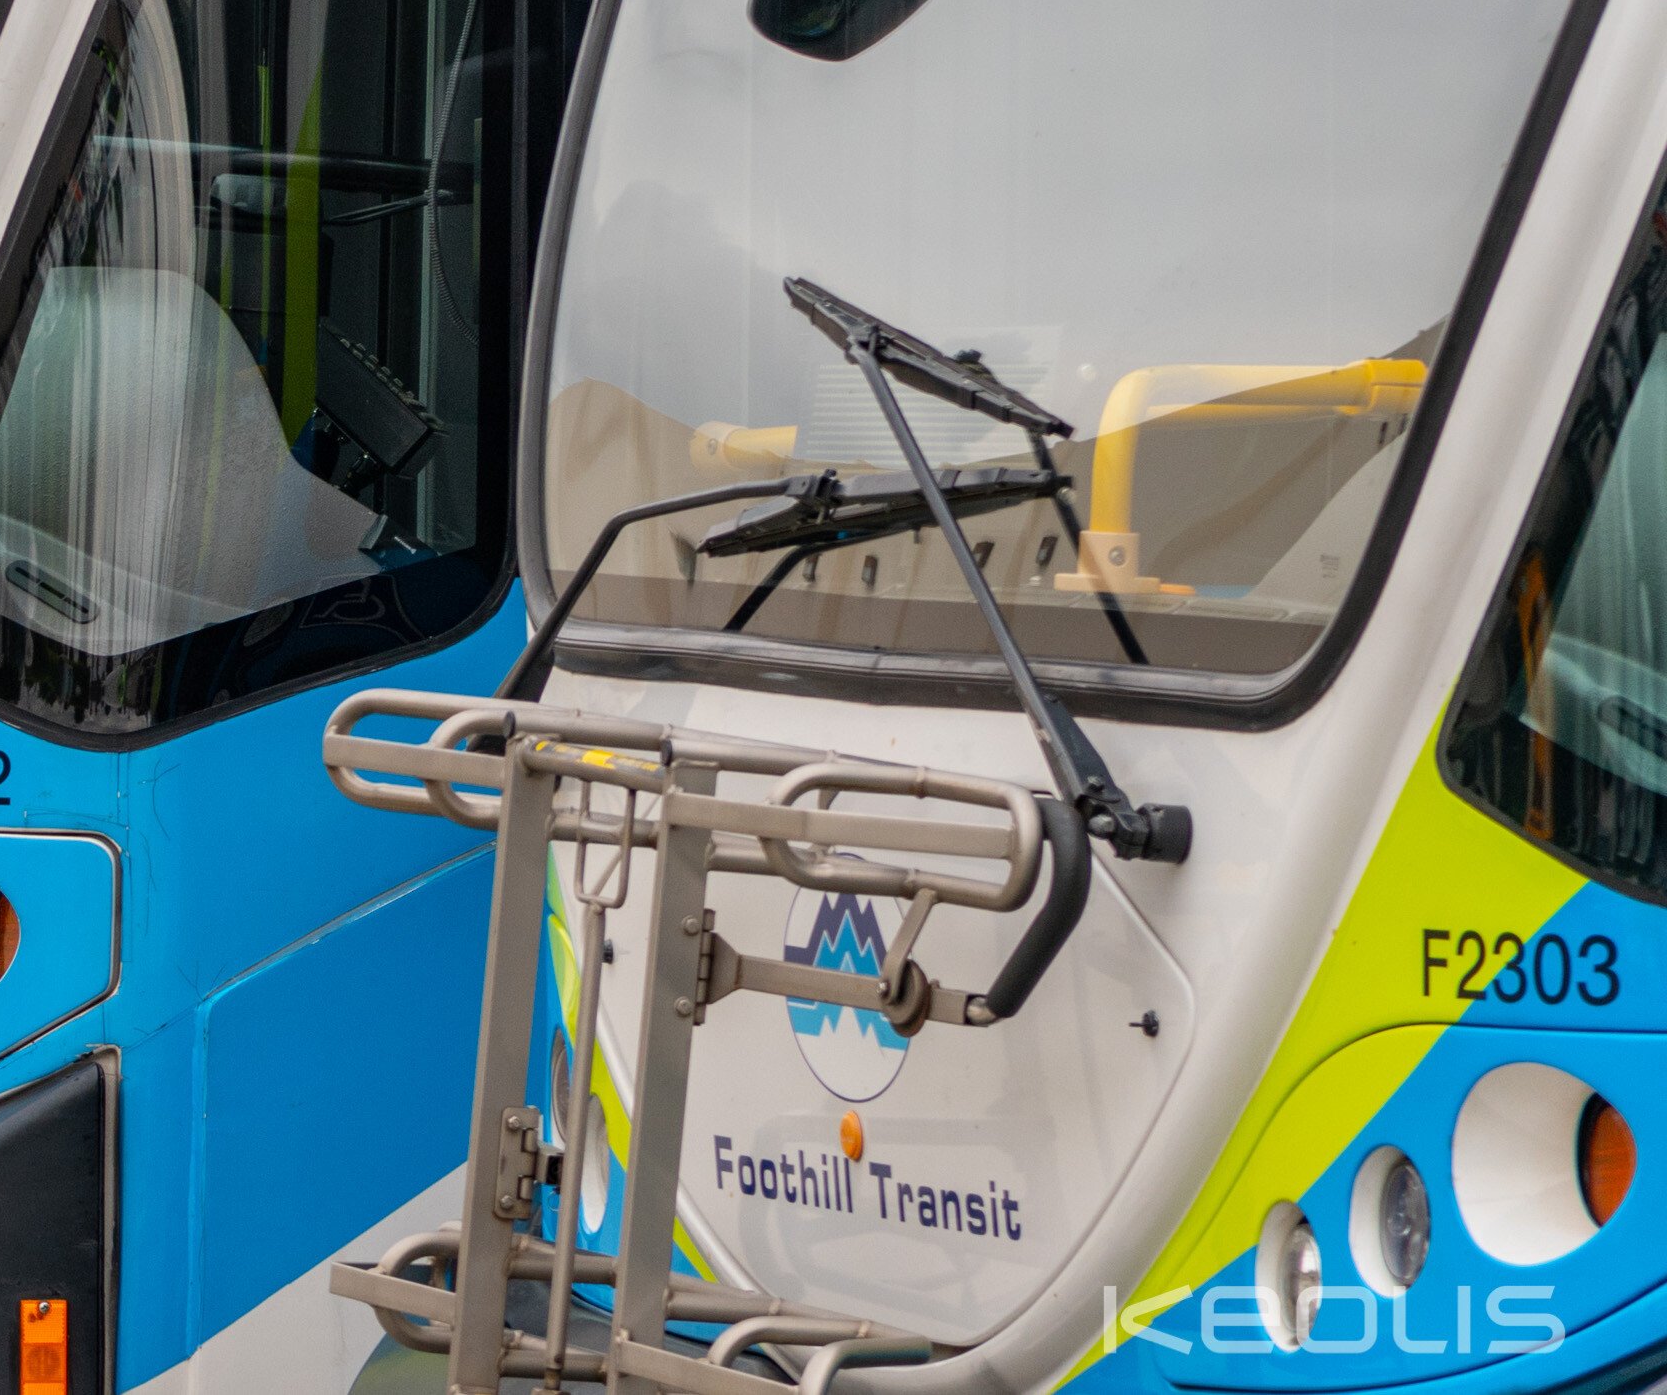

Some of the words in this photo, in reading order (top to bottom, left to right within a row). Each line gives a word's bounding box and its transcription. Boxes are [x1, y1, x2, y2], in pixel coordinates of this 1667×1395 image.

[1423, 929, 1620, 1006] F2303
[713, 1134, 854, 1213] Foothill
[869, 1161, 1021, 1241] Transit
